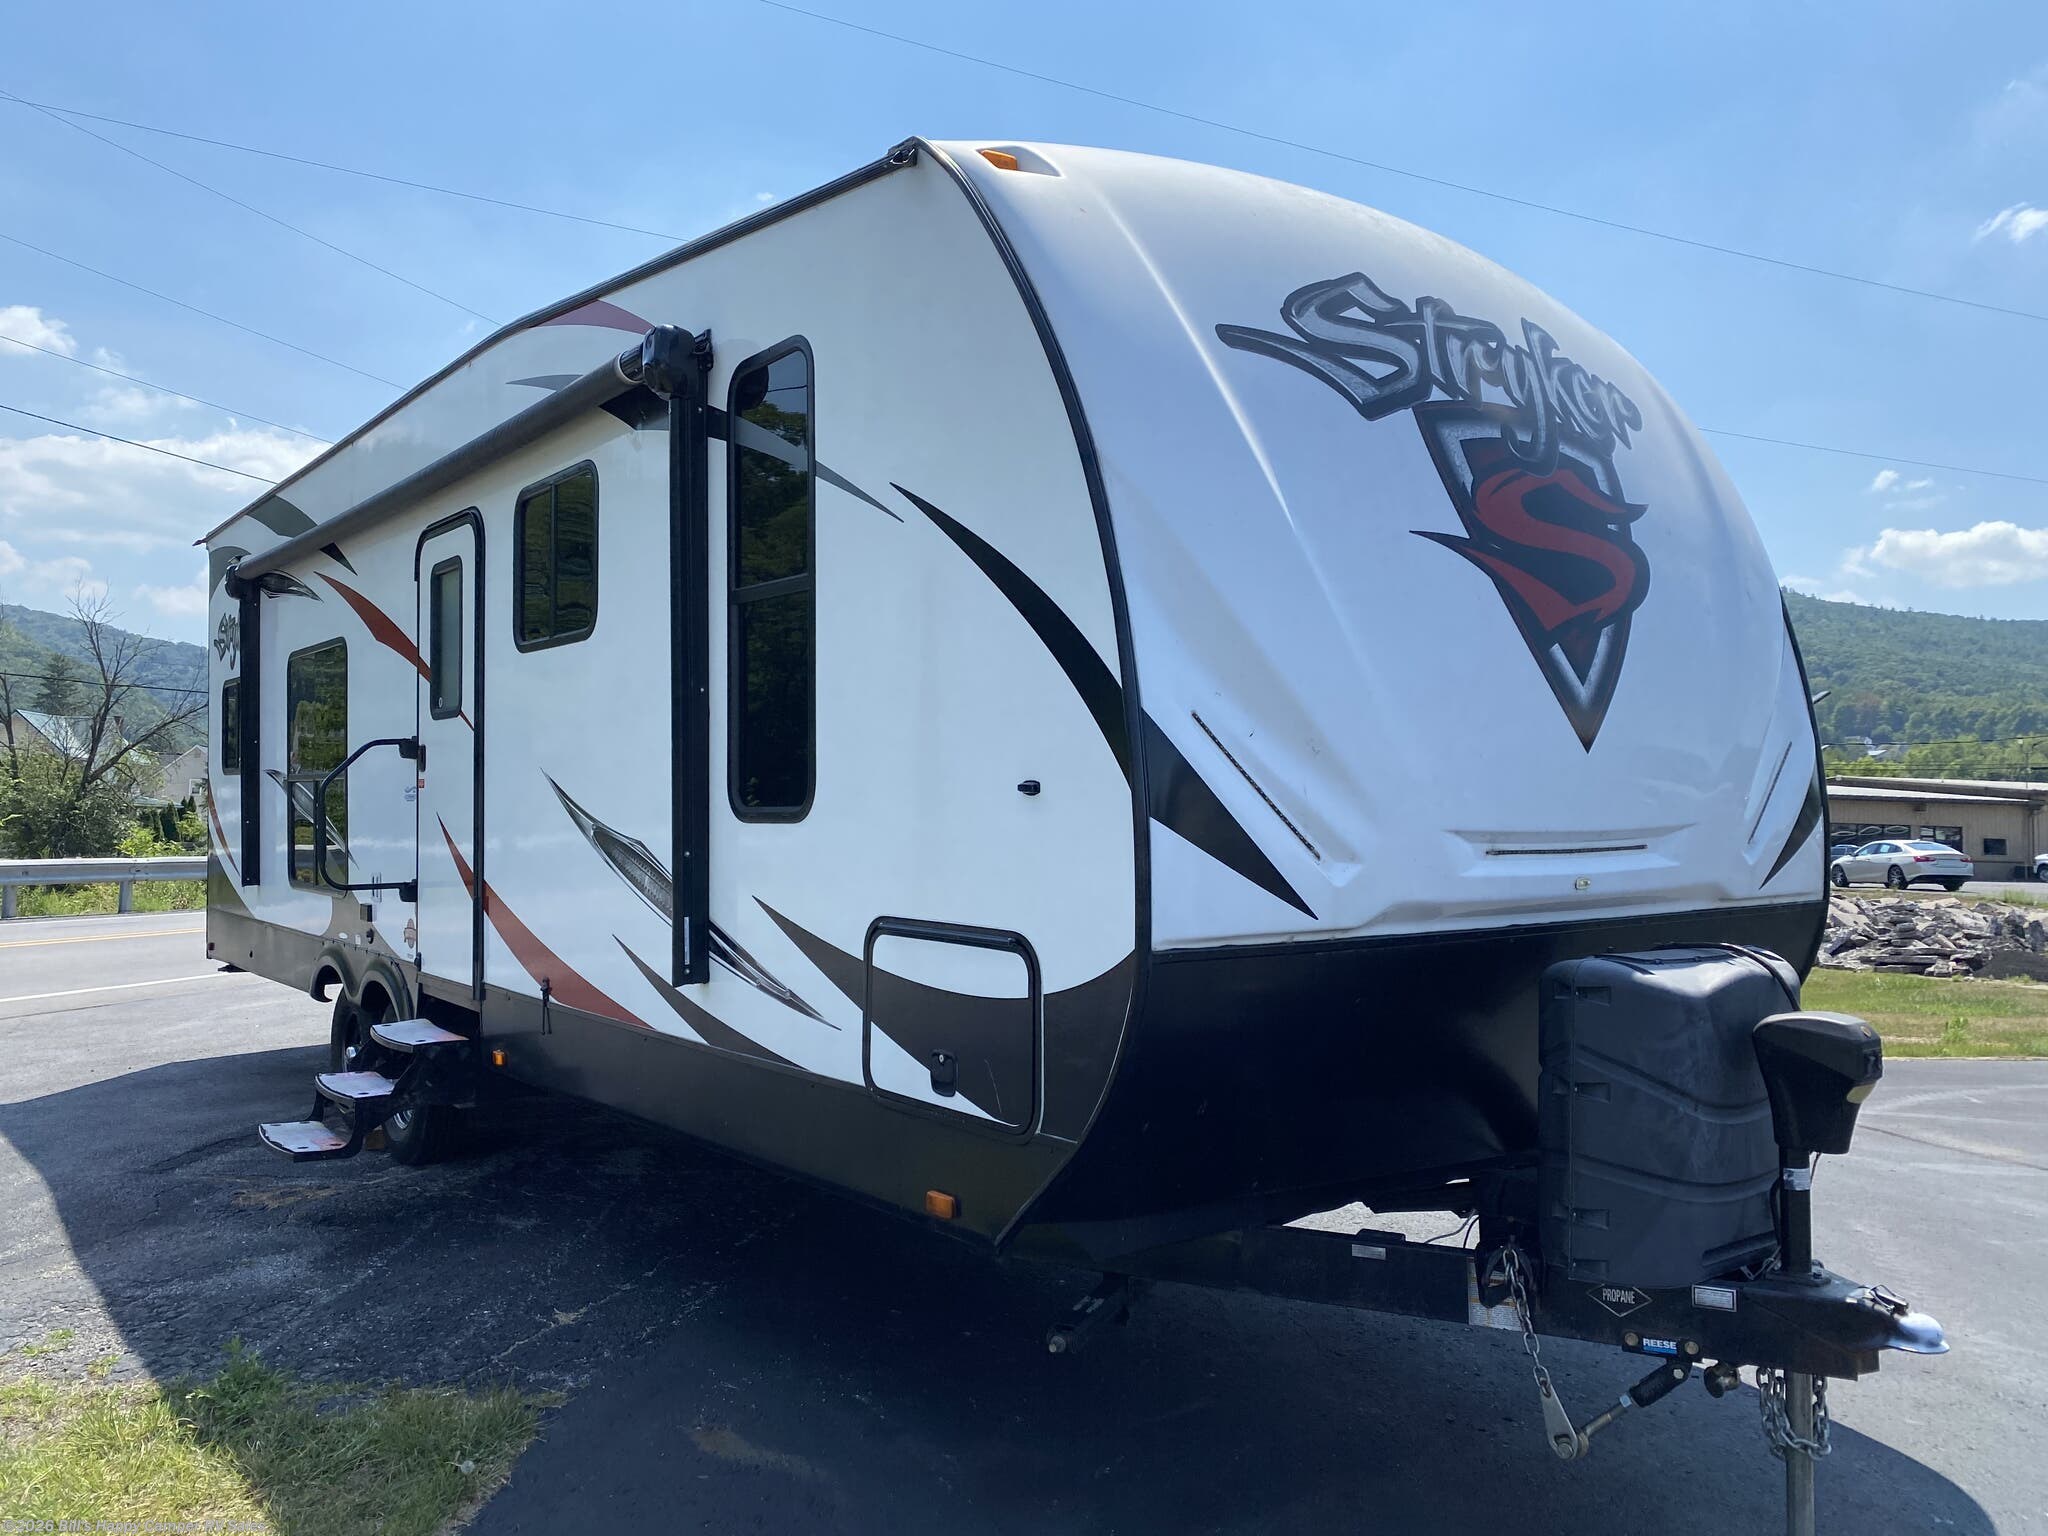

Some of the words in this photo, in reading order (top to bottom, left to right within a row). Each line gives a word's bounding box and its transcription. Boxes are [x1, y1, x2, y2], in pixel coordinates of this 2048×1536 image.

[1215, 271, 1643, 477] Stryker
[1602, 1288, 1636, 1304] PROPANE
[1642, 1337, 1678, 1350] REESE
